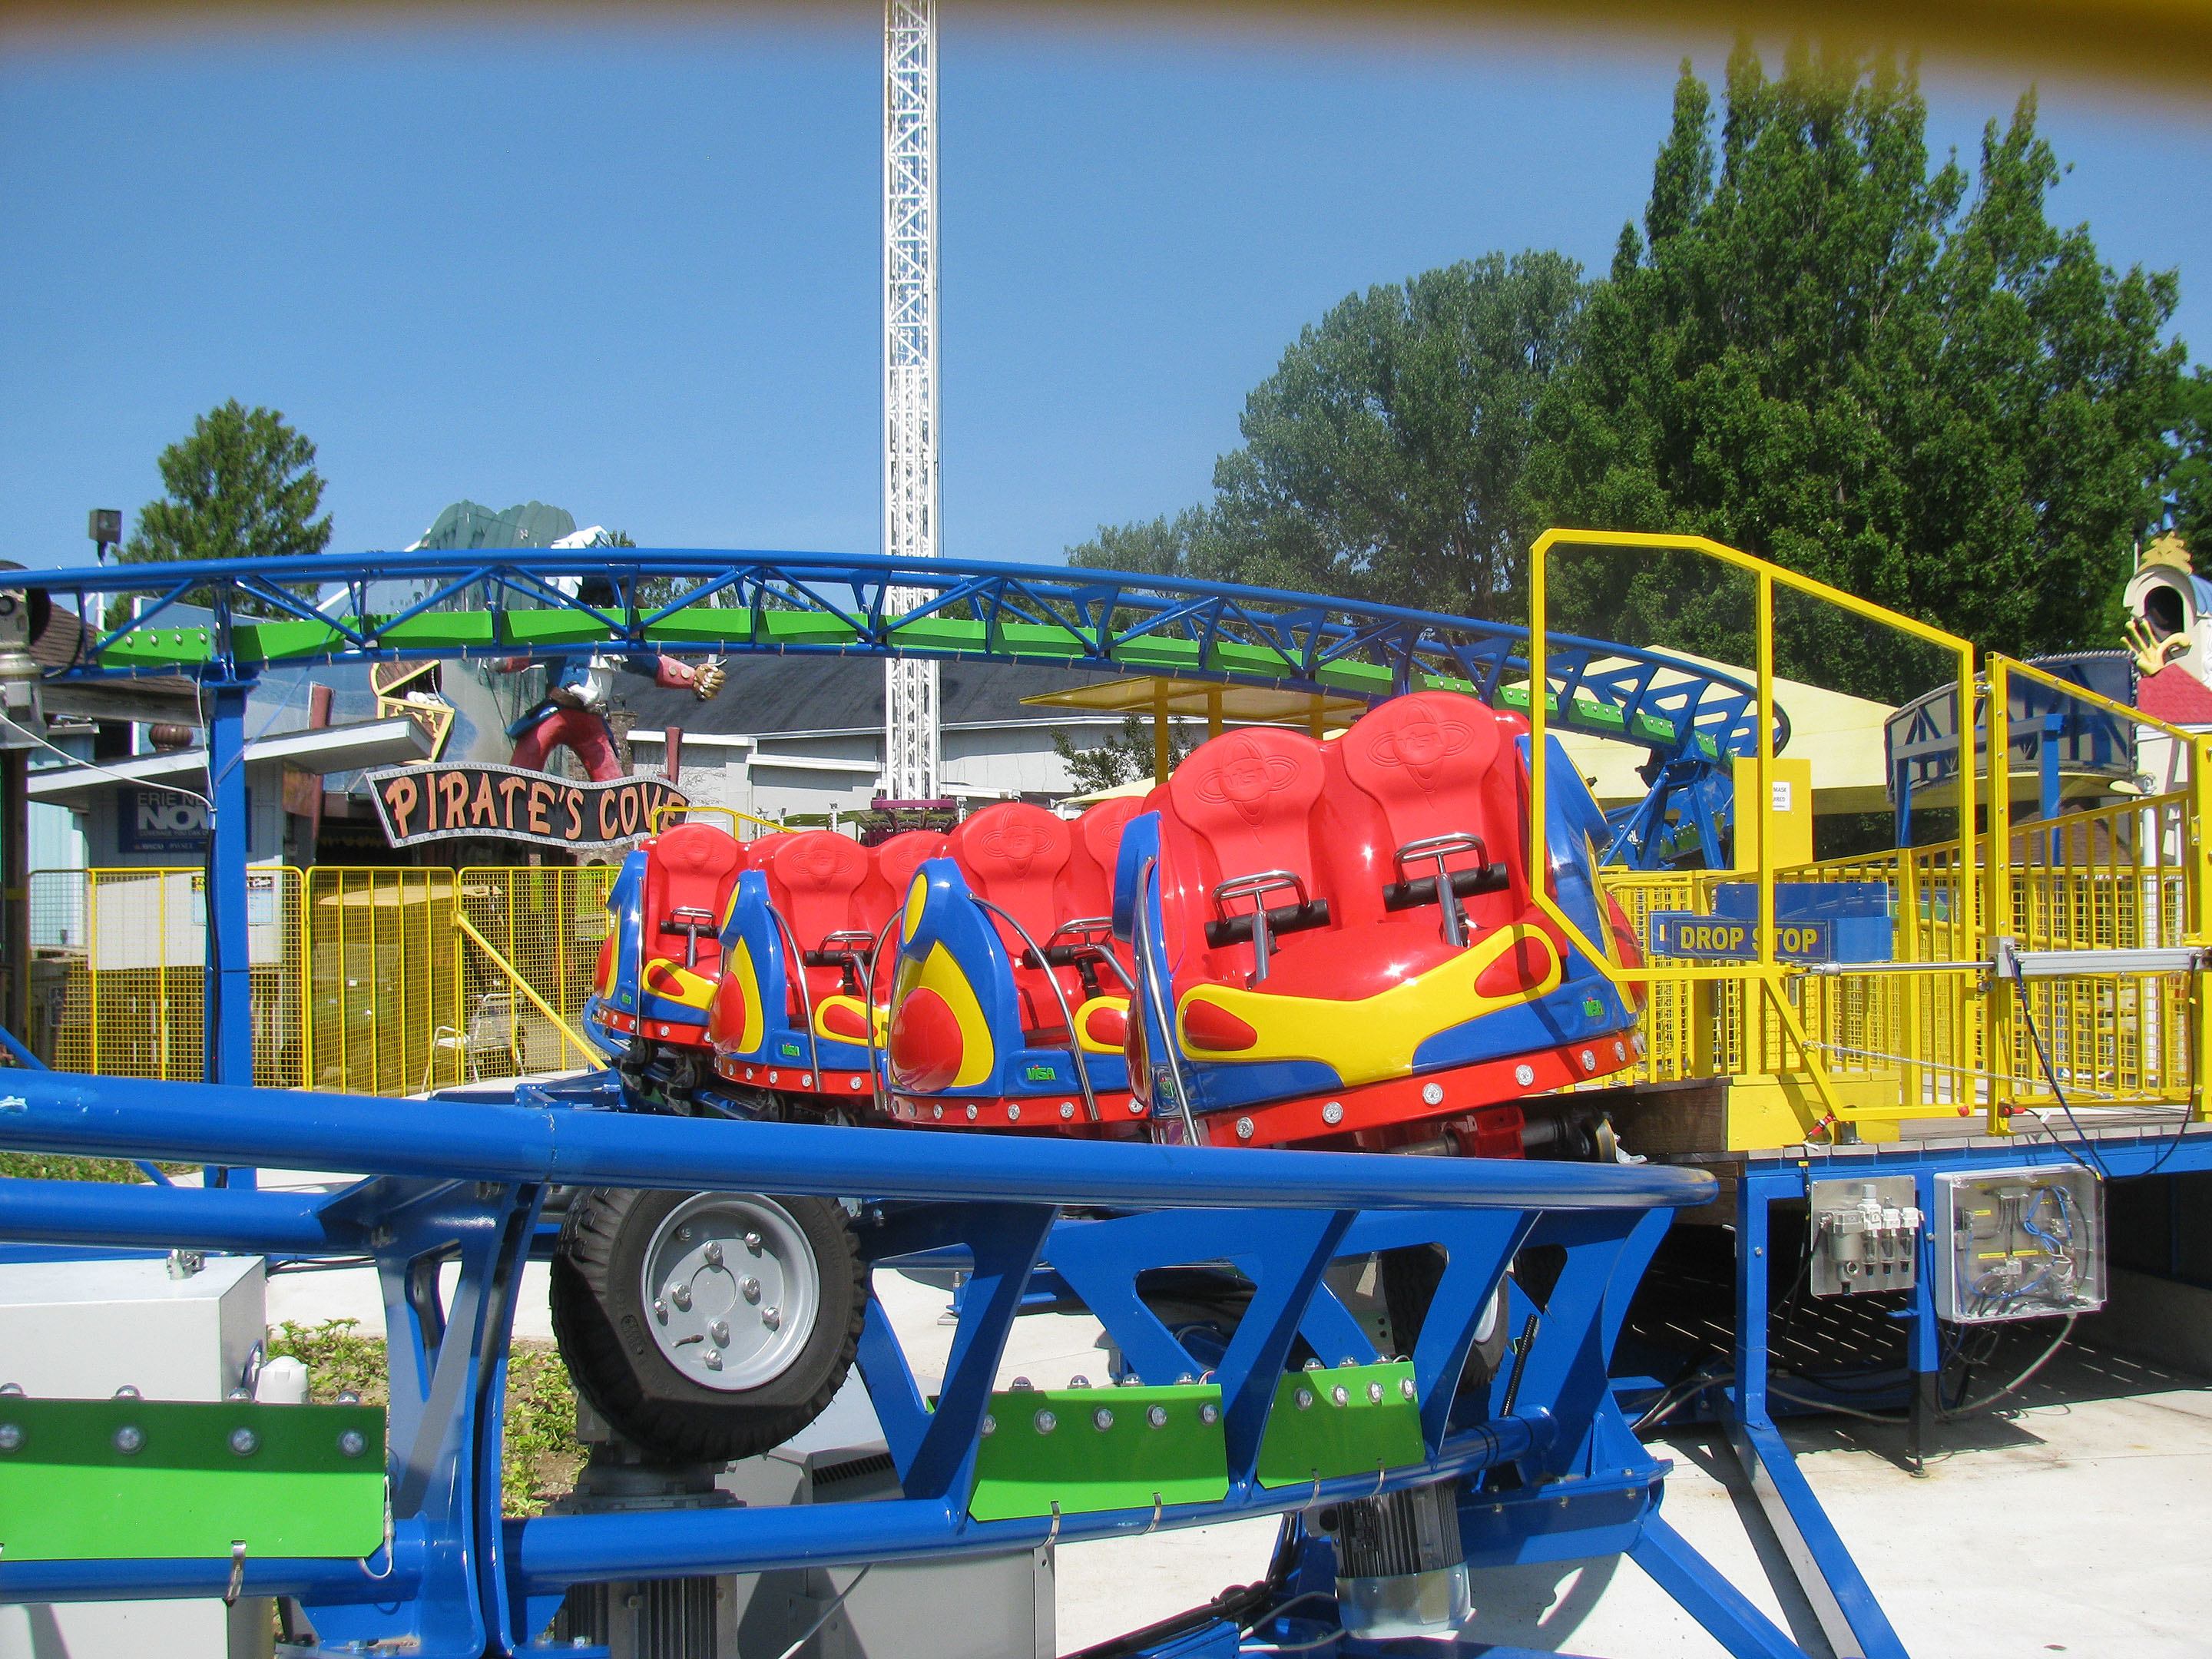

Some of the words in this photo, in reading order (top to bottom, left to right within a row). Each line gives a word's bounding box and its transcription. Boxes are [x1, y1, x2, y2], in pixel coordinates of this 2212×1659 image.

[137, 793, 177, 806] ERIE
[385, 771, 584, 841] PIRATE'S
[599, 783, 687, 840] COVE
[1681, 926, 1744, 951] DROP
